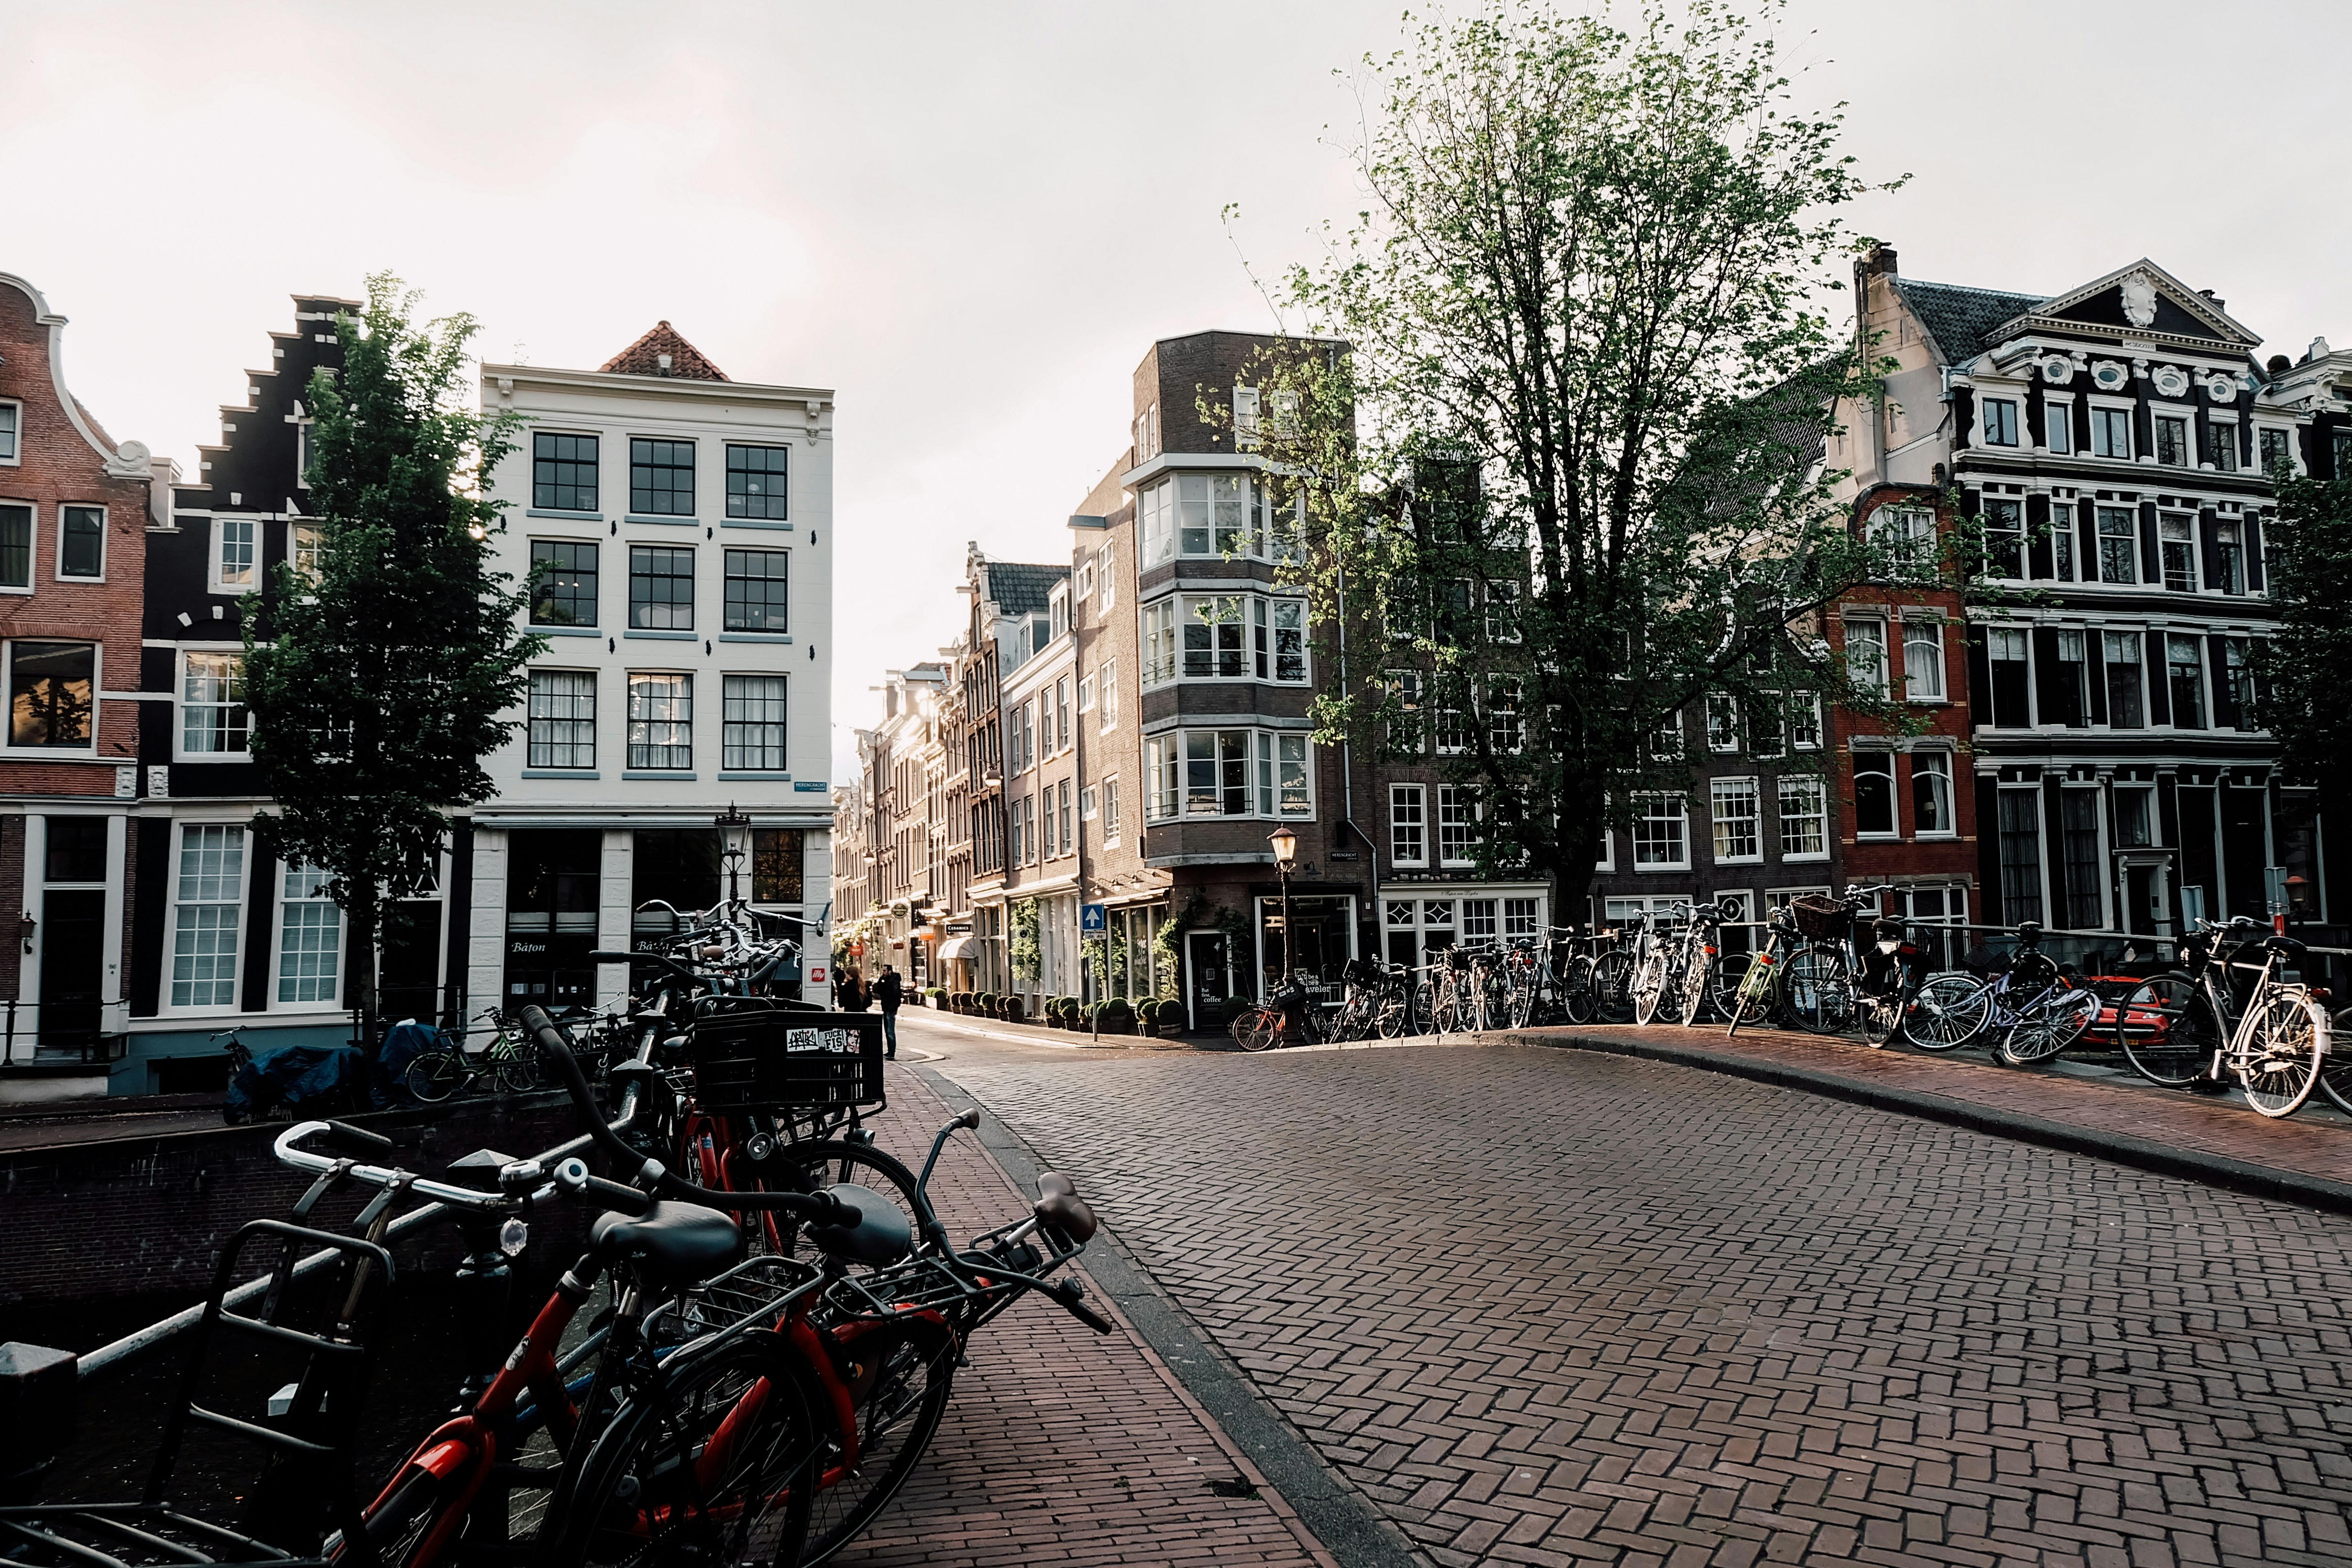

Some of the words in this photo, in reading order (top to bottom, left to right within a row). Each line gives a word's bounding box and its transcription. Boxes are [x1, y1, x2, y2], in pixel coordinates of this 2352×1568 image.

[813, 970, 824, 980] illy
[1305, 985, 1331, 993] aveler
[824, 1030, 841, 1039] FUCK
[825, 1037, 842, 1049] FIS
